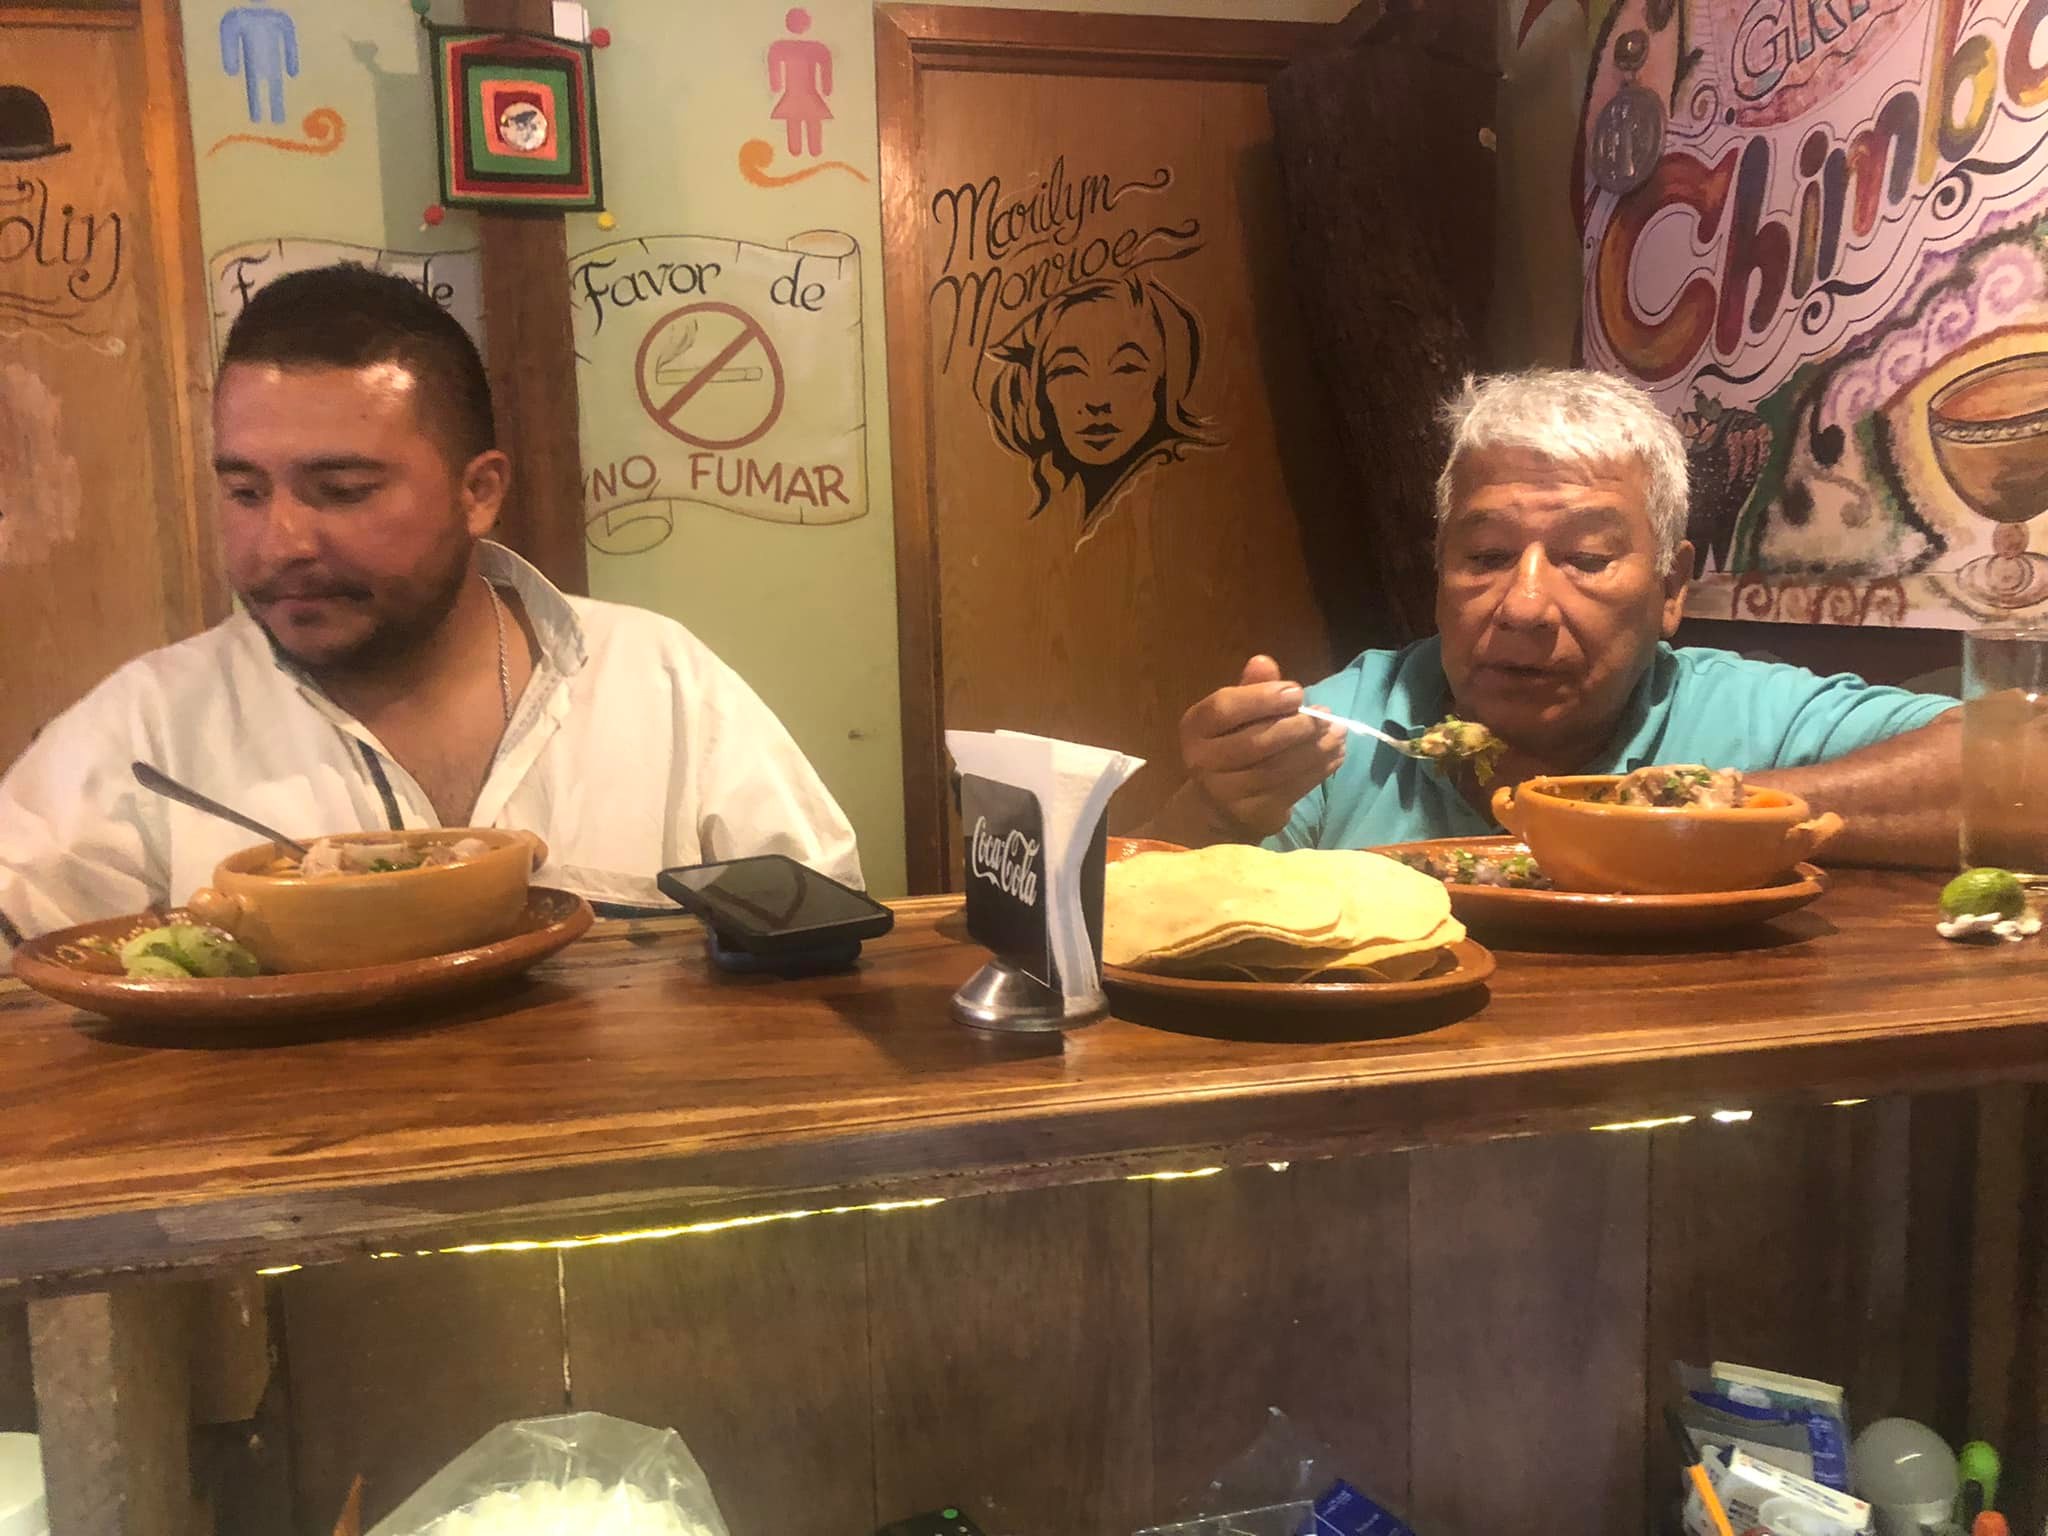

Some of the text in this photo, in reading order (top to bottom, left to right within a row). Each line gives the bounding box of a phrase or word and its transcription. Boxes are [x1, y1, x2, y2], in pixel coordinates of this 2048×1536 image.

[932, 154, 1171, 275] Marilyn
[572, 256, 826, 336] Favor de
[593, 453, 850, 507] NO FUMAR
